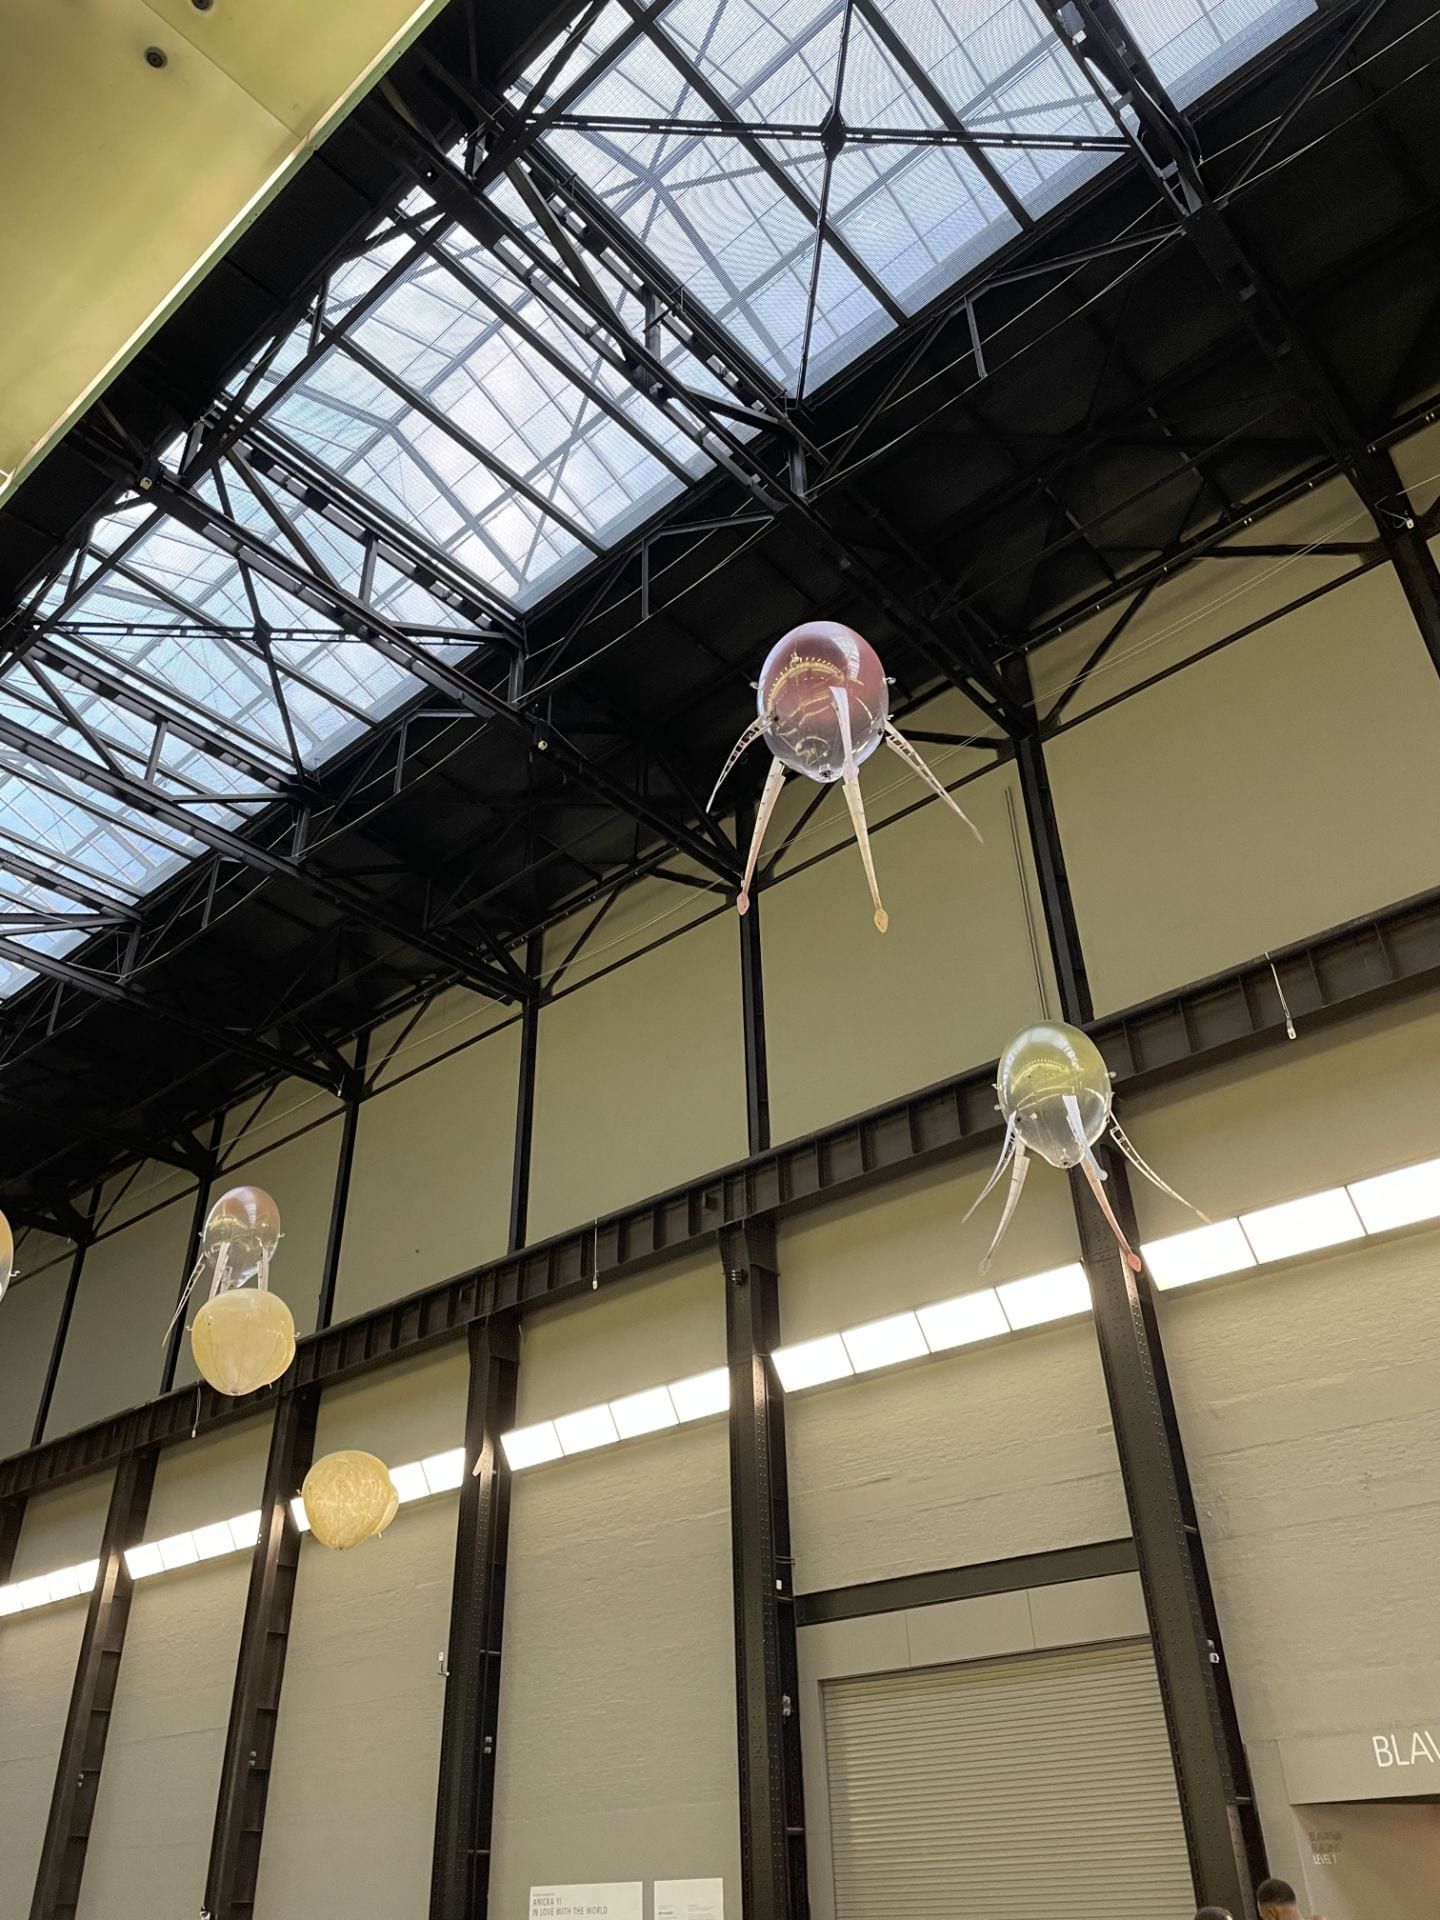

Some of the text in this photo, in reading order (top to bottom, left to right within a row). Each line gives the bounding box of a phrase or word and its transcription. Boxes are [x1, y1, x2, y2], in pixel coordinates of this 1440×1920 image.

[1312, 1854, 1331, 1865] LEVEL
[540, 1907, 554, 1917] LOVE
[556, 1907, 572, 1916] WITH
[573, 1906, 585, 1916] THE
[586, 1905, 608, 1915] WORLD
